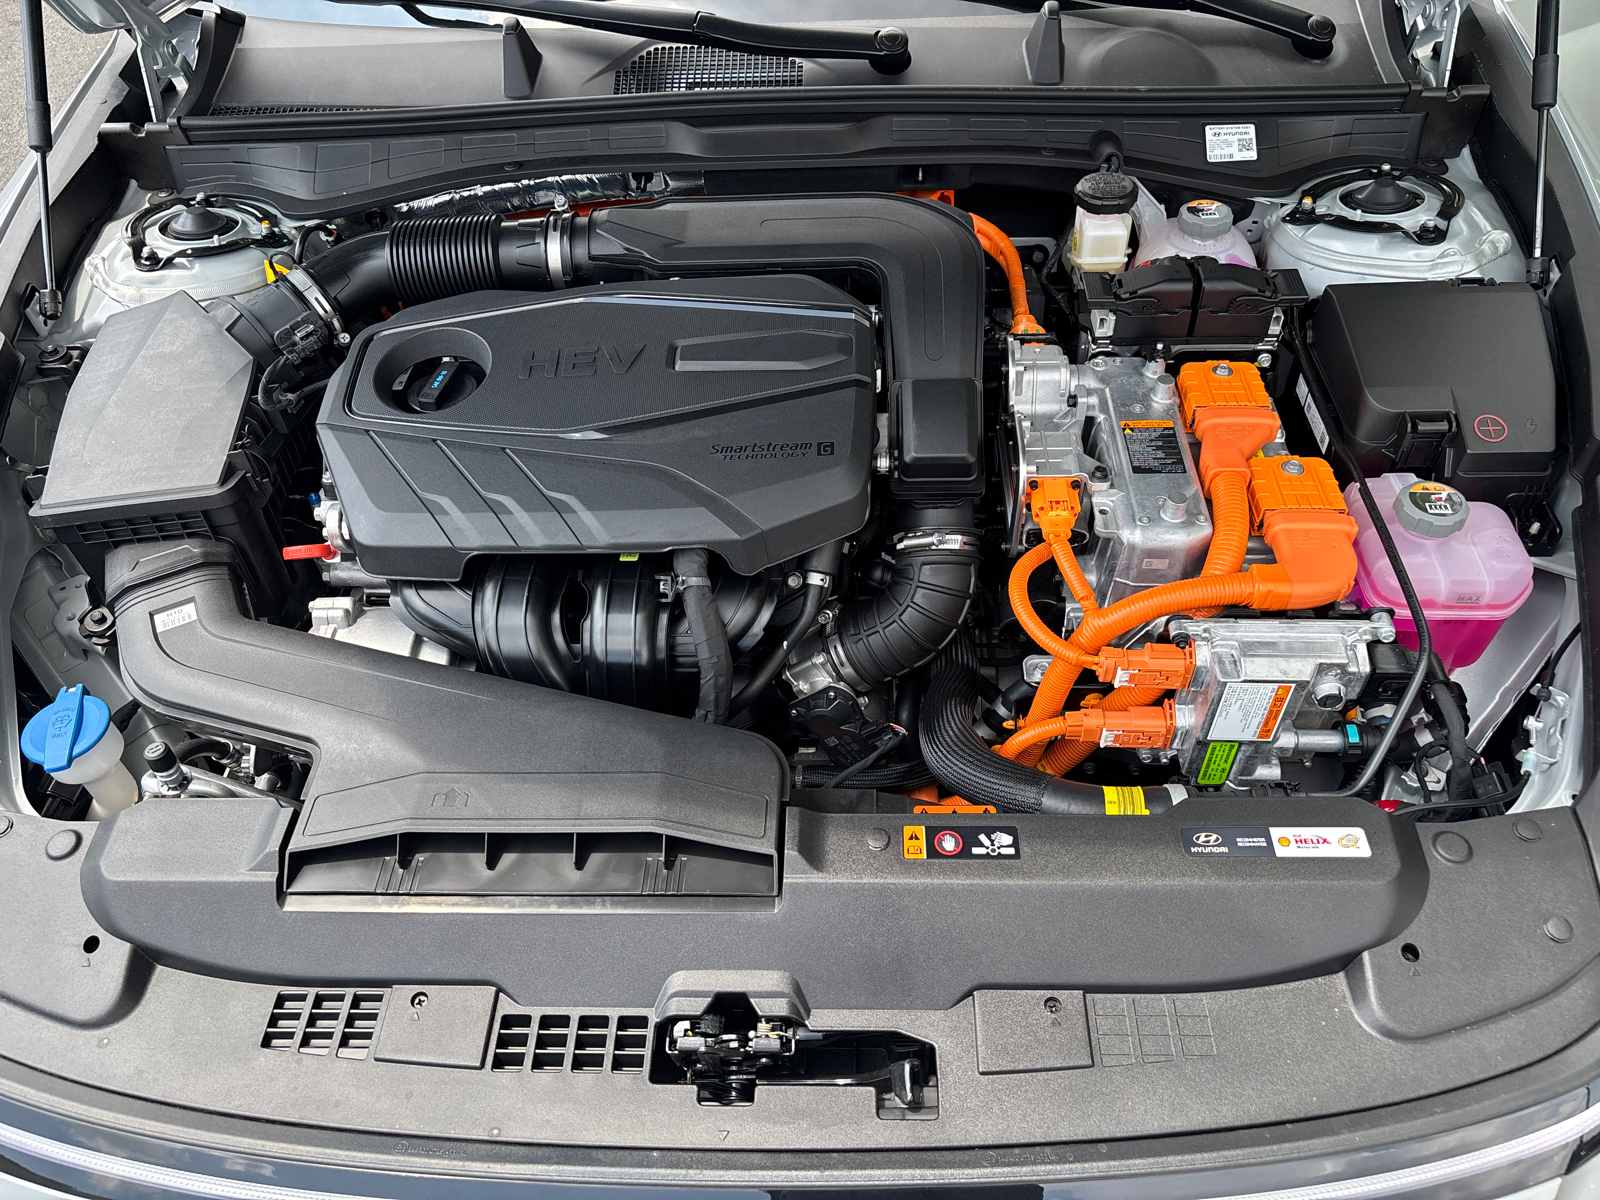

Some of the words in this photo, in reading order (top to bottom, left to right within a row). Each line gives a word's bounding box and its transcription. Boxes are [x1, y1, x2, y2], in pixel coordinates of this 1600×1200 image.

[519, 343, 647, 379] HEV
[709, 442, 813, 454] Smartstream
[818, 442, 833, 455] G
[722, 451, 810, 460] TECHNOLOGY
[51, 731, 67, 739] ONLY
[1294, 837, 1331, 845] HELIX
